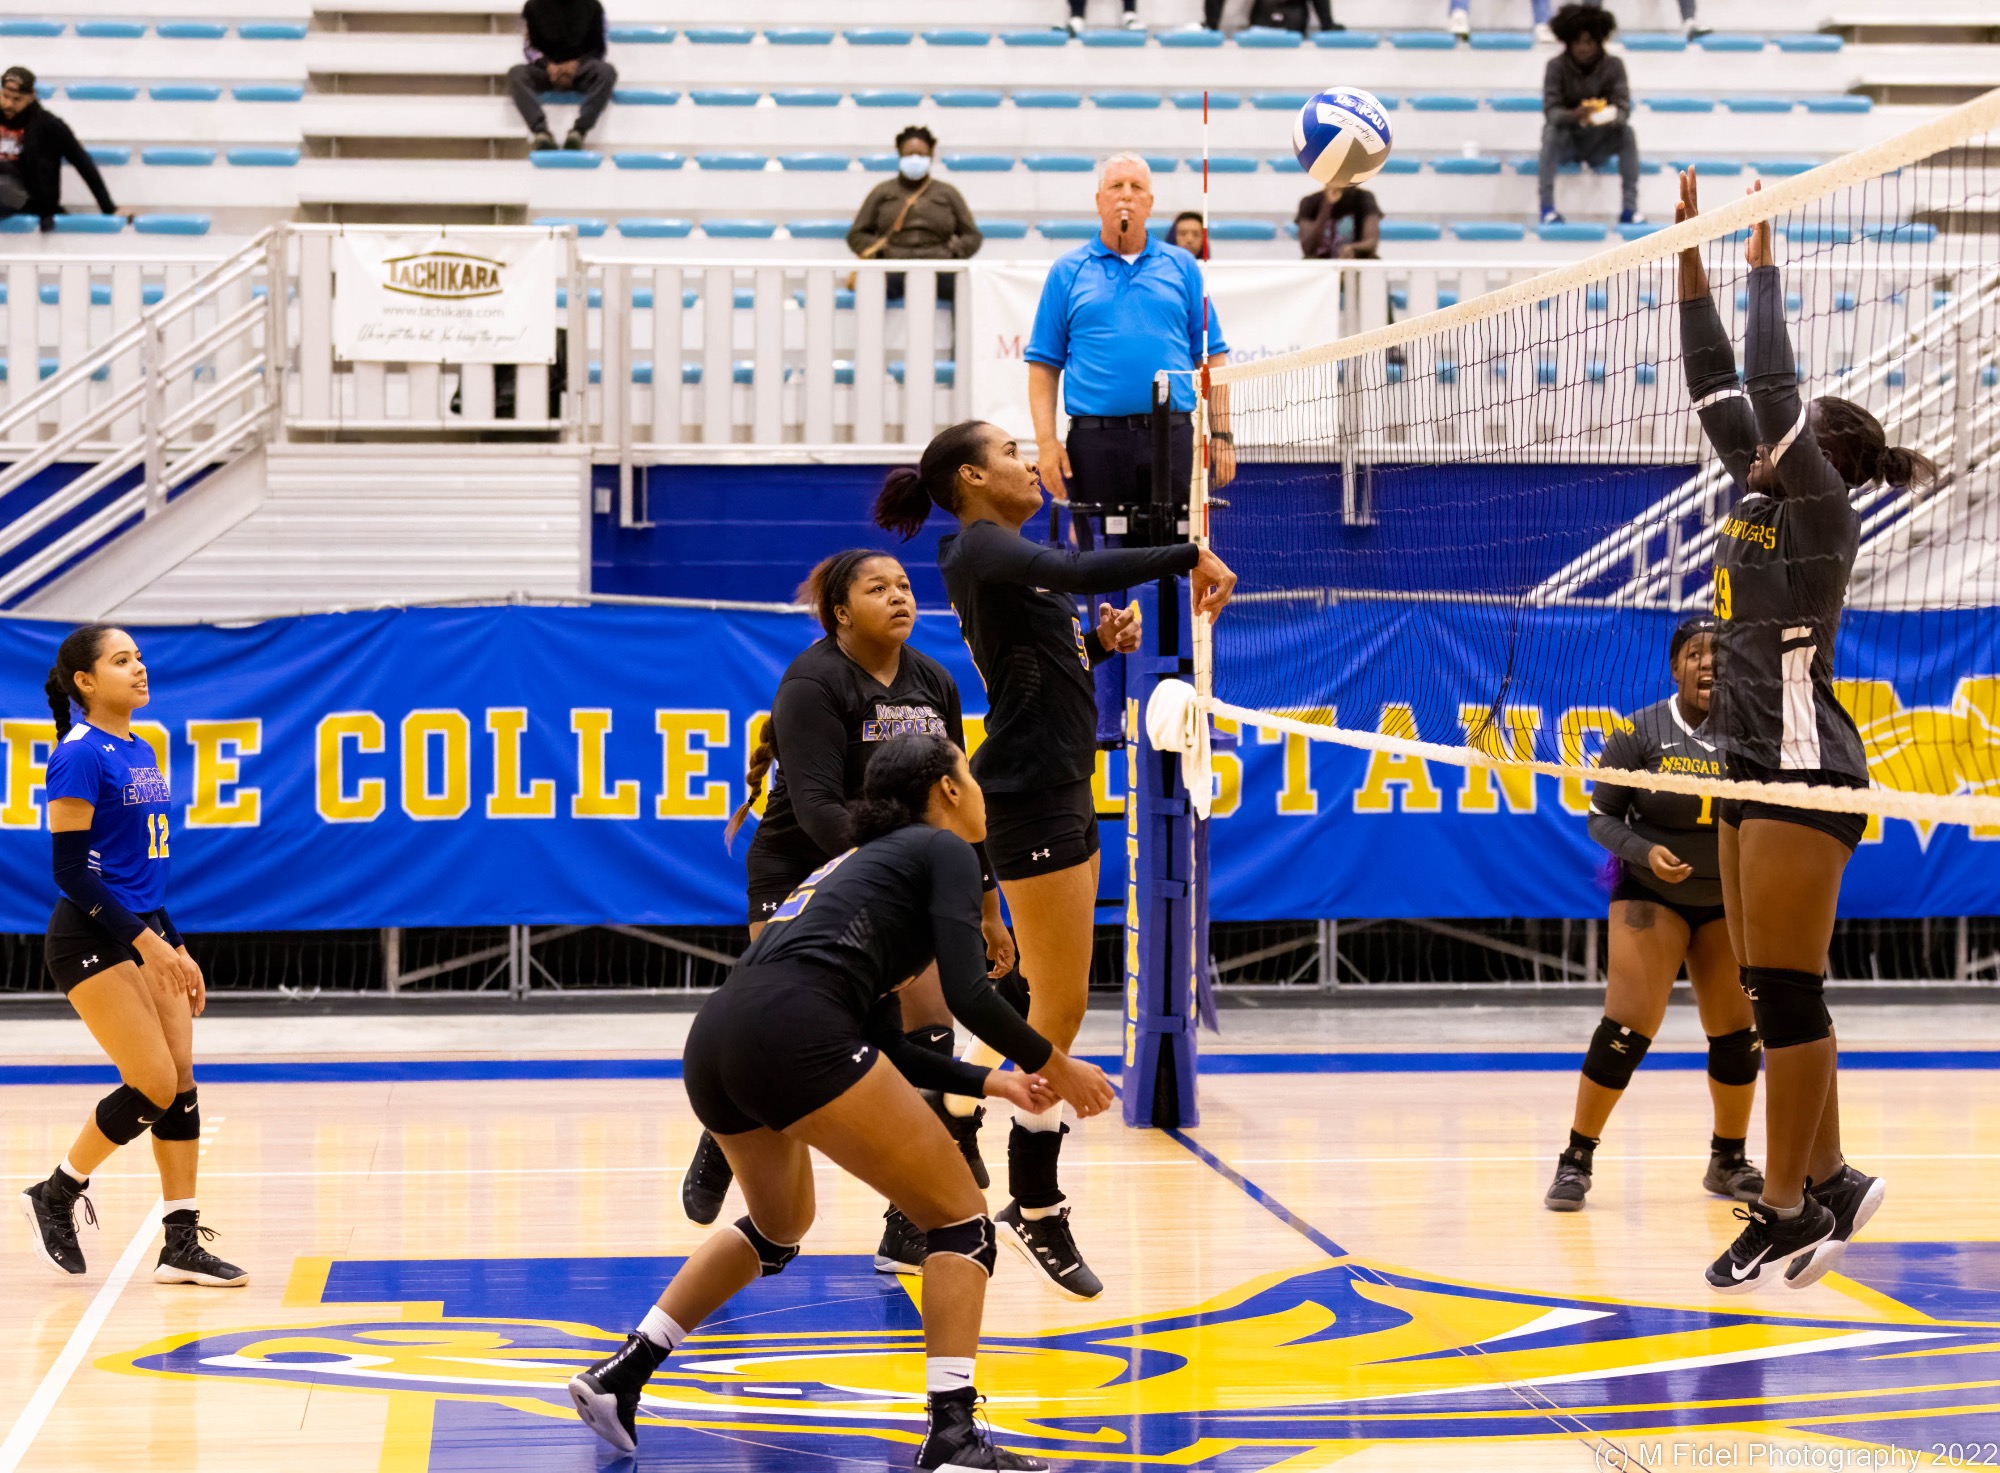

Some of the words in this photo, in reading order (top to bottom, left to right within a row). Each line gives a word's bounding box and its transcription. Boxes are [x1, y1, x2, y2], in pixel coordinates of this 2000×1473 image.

[388, 260, 499, 291] TACHIKARA
[862, 717, 948, 742] EXPRESS
[1658, 755, 1721, 775] MEDGAR
[147, 813, 170, 859] 12
